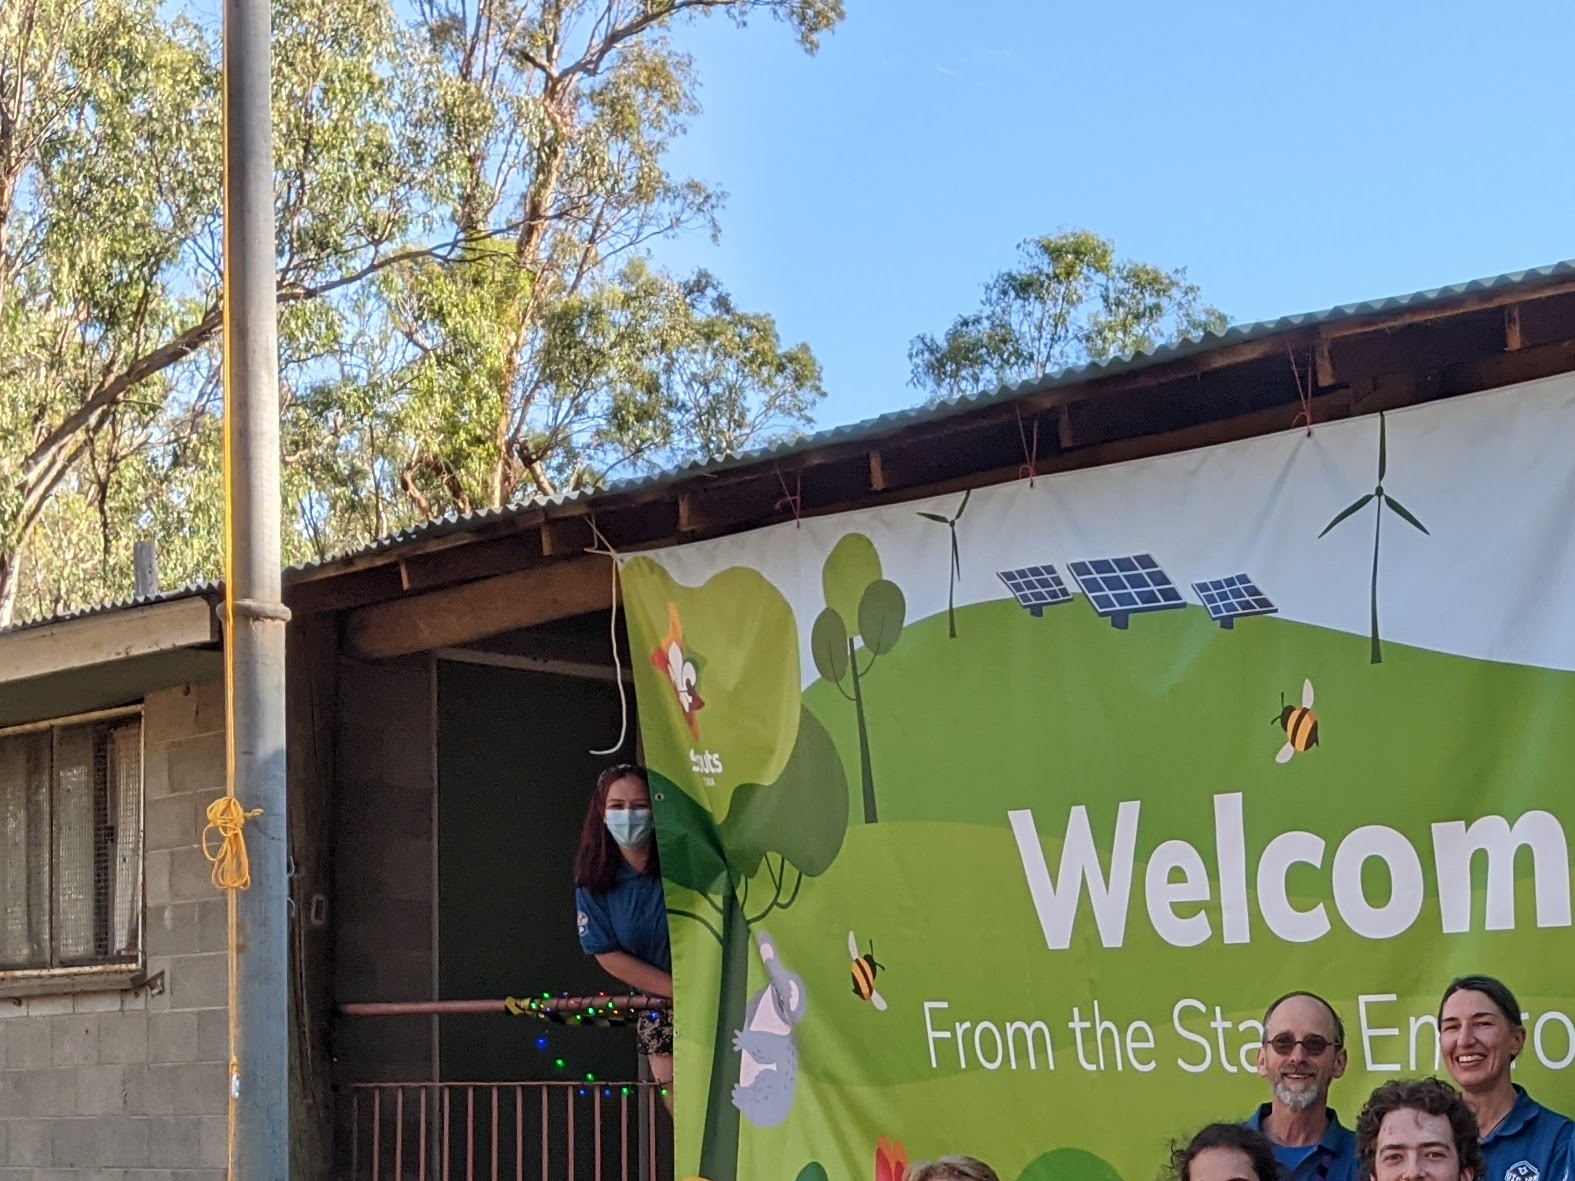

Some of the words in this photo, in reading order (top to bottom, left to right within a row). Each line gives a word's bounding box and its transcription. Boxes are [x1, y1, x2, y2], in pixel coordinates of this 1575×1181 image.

[922, 1000, 1055, 1070] From
[1067, 1000, 1157, 1073] the
[1171, 997, 1265, 1074] Sta
